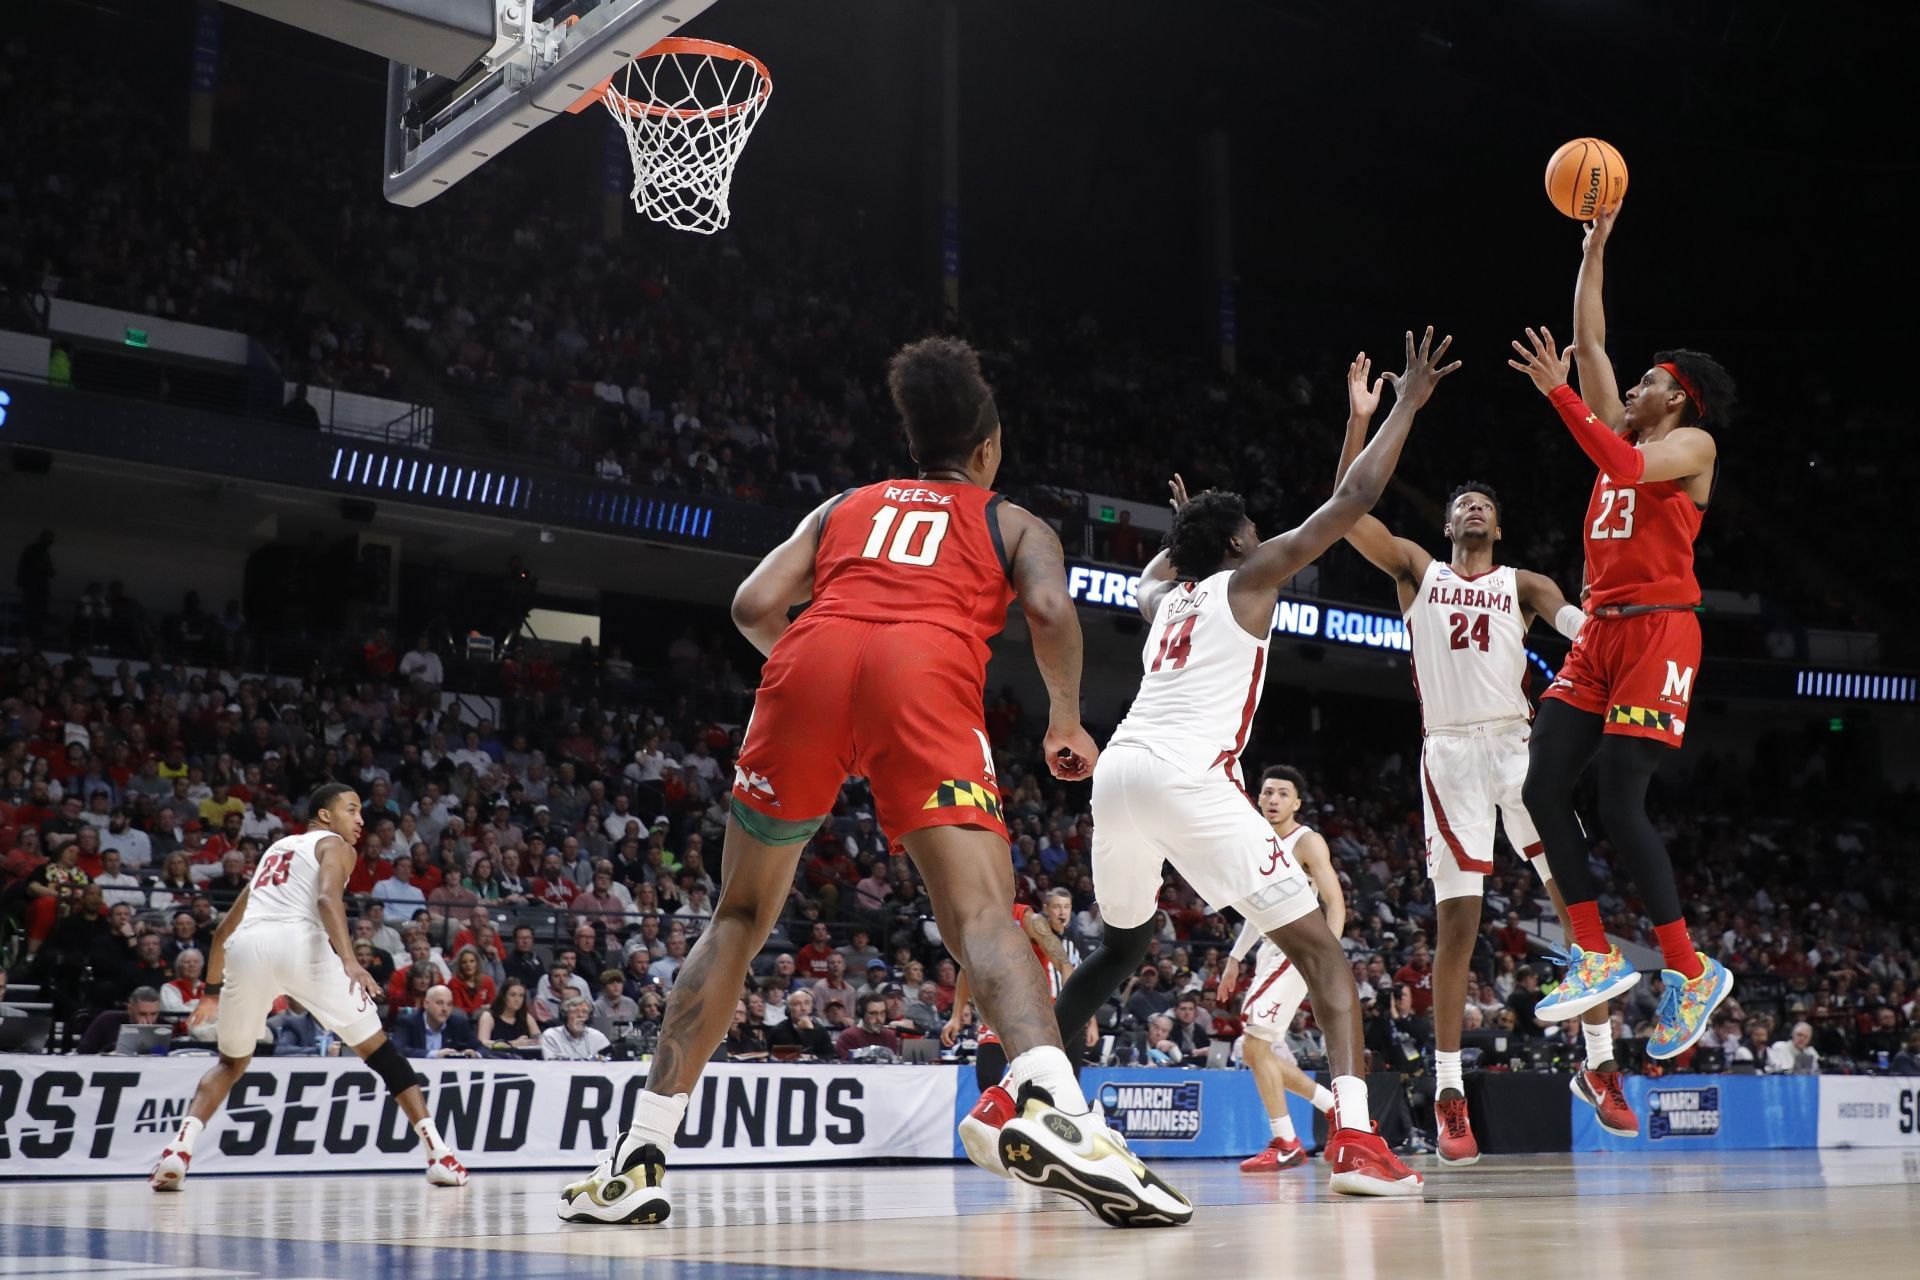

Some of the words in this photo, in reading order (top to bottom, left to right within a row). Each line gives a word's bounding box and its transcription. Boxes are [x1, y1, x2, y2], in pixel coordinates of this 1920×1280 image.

[1580, 166, 1600, 216] Wilson
[884, 486, 955, 505] REESE
[1590, 487, 1636, 540] 23
[861, 504, 951, 567] 10
[1068, 566, 1141, 608] FIRS
[1272, 600, 1319, 636] ND
[1325, 608, 1411, 651] ROUN
[1428, 586, 1512, 614] ALABAMA
[1151, 614, 1198, 672] 14
[1449, 612, 1490, 653] 24
[1660, 660, 1693, 702] M
[253, 850, 295, 890] 25
[134, 1098, 194, 1133] AN
[1117, 1087, 1174, 1109] MARCH
[1660, 1091, 1700, 1111] MARCH
[1899, 1089, 1920, 1134] S
[1126, 1109, 1200, 1131] MADNESS
[1668, 1110, 1720, 1129] MADNESS
